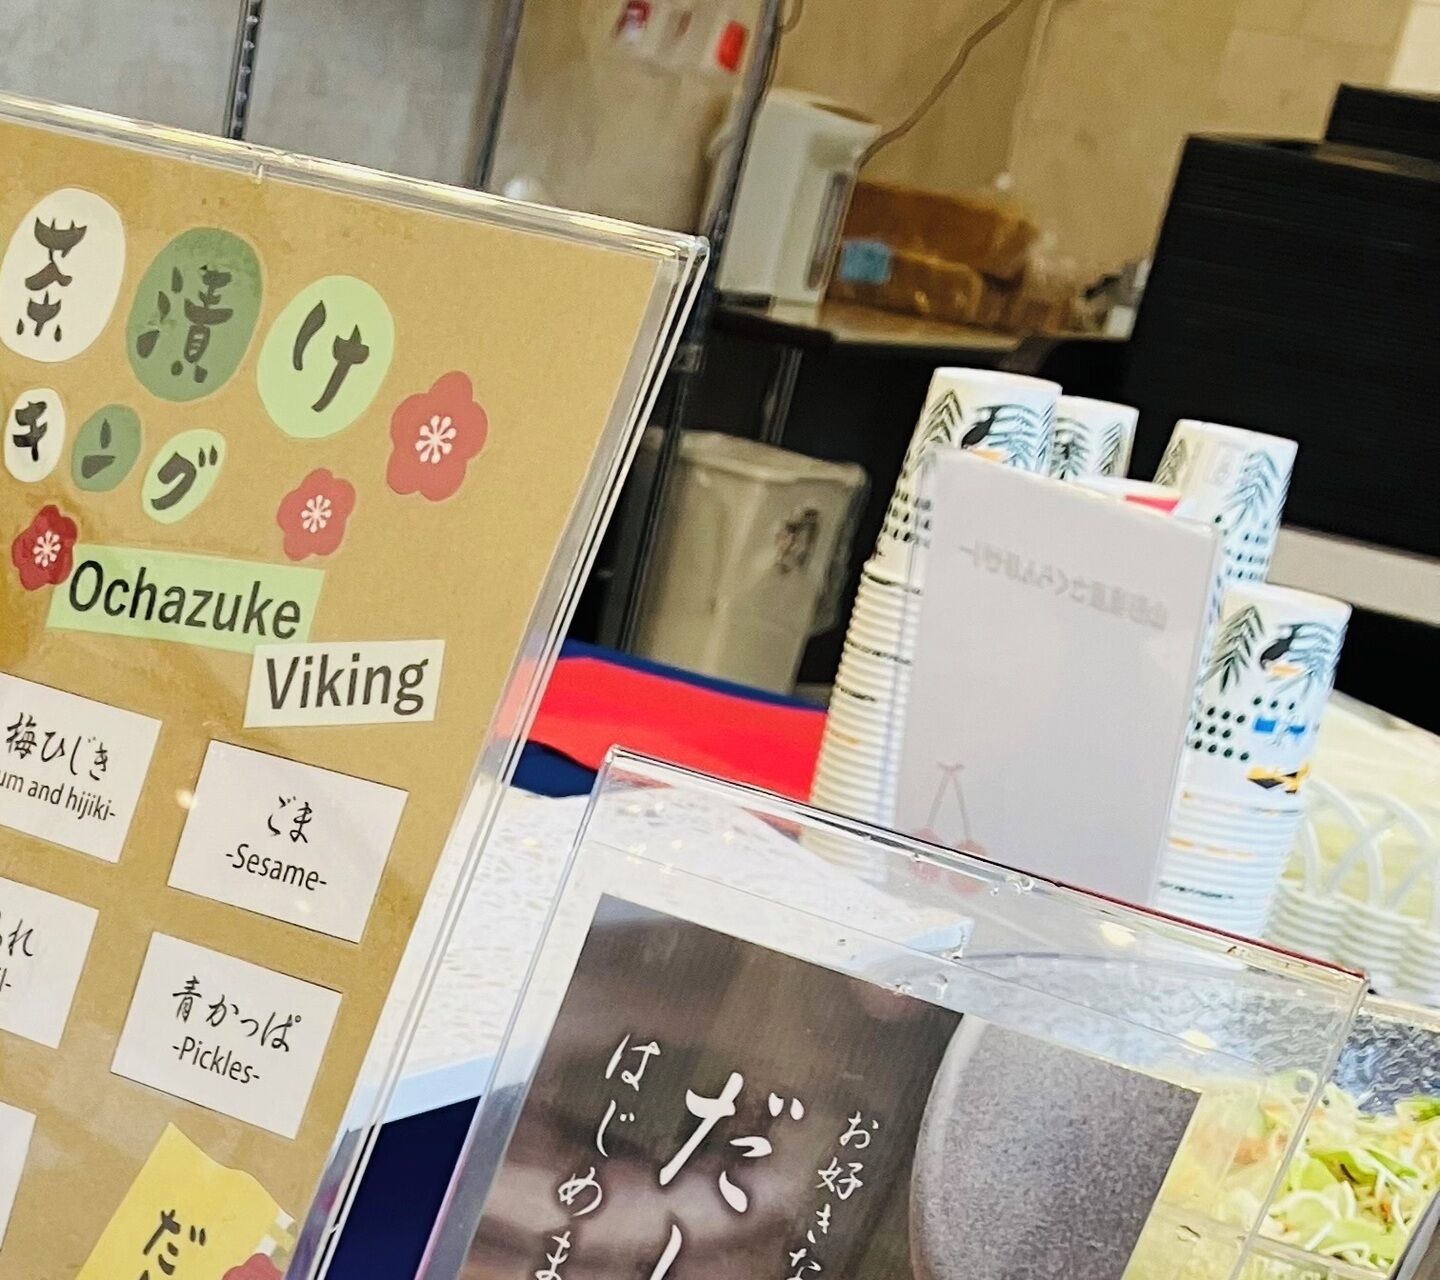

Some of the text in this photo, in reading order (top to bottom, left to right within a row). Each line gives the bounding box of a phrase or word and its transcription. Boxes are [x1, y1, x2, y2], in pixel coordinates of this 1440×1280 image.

[68, 559, 301, 640] Ochazuke
[265, 653, 430, 715] Viking
[6, 712, 108, 781] 梅ひじき
[27, 781, 65, 805] and
[65, 786, 116, 821] hijiki-
[266, 796, 312, 845] ごま
[225, 843, 329, 893] -Sesame-
[172, 975, 302, 1053] 青かっぱ
[171, 1040, 260, 1086] -Pickles-
